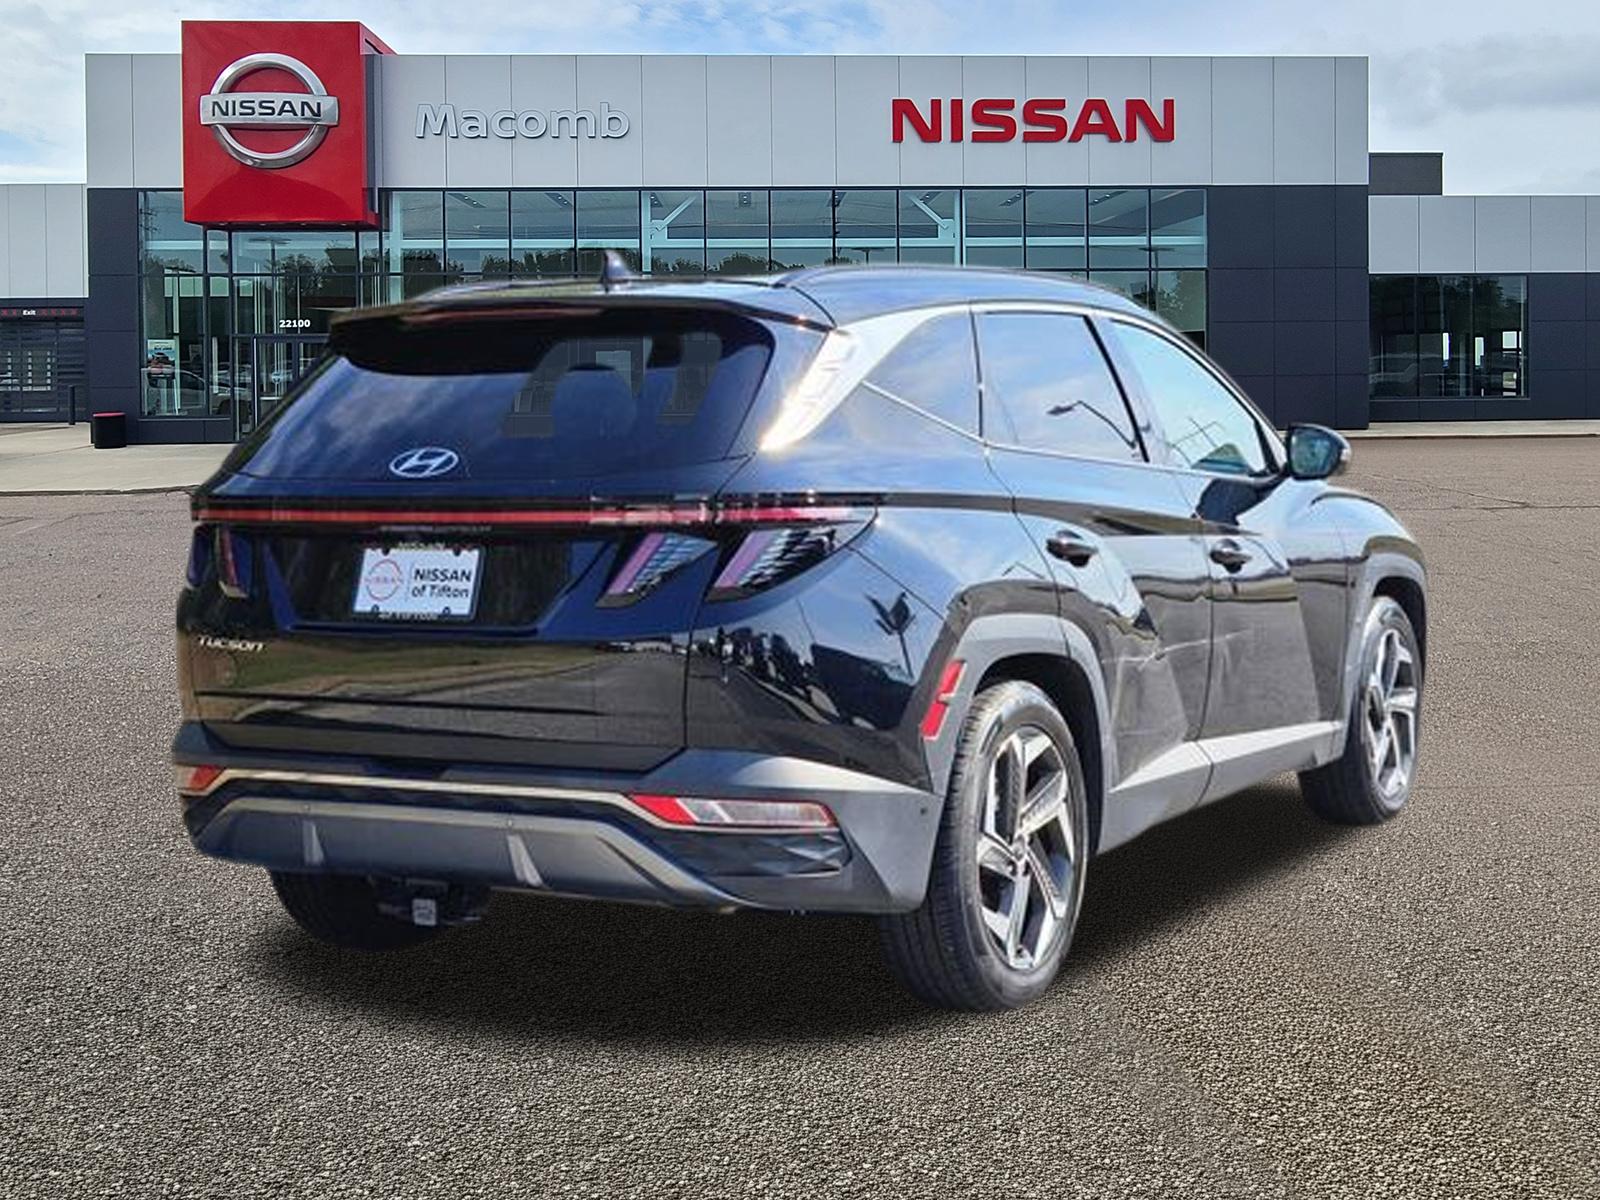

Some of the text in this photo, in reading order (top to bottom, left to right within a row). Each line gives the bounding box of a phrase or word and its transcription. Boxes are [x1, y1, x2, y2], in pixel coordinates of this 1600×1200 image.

[211, 100, 322, 118] NISSAN
[415, 102, 630, 139] Macomb
[892, 98, 1175, 143] NISSAN
[279, 319, 311, 328] 22100
[414, 568, 472, 582] NISSAN
[411, 584, 427, 598] of
